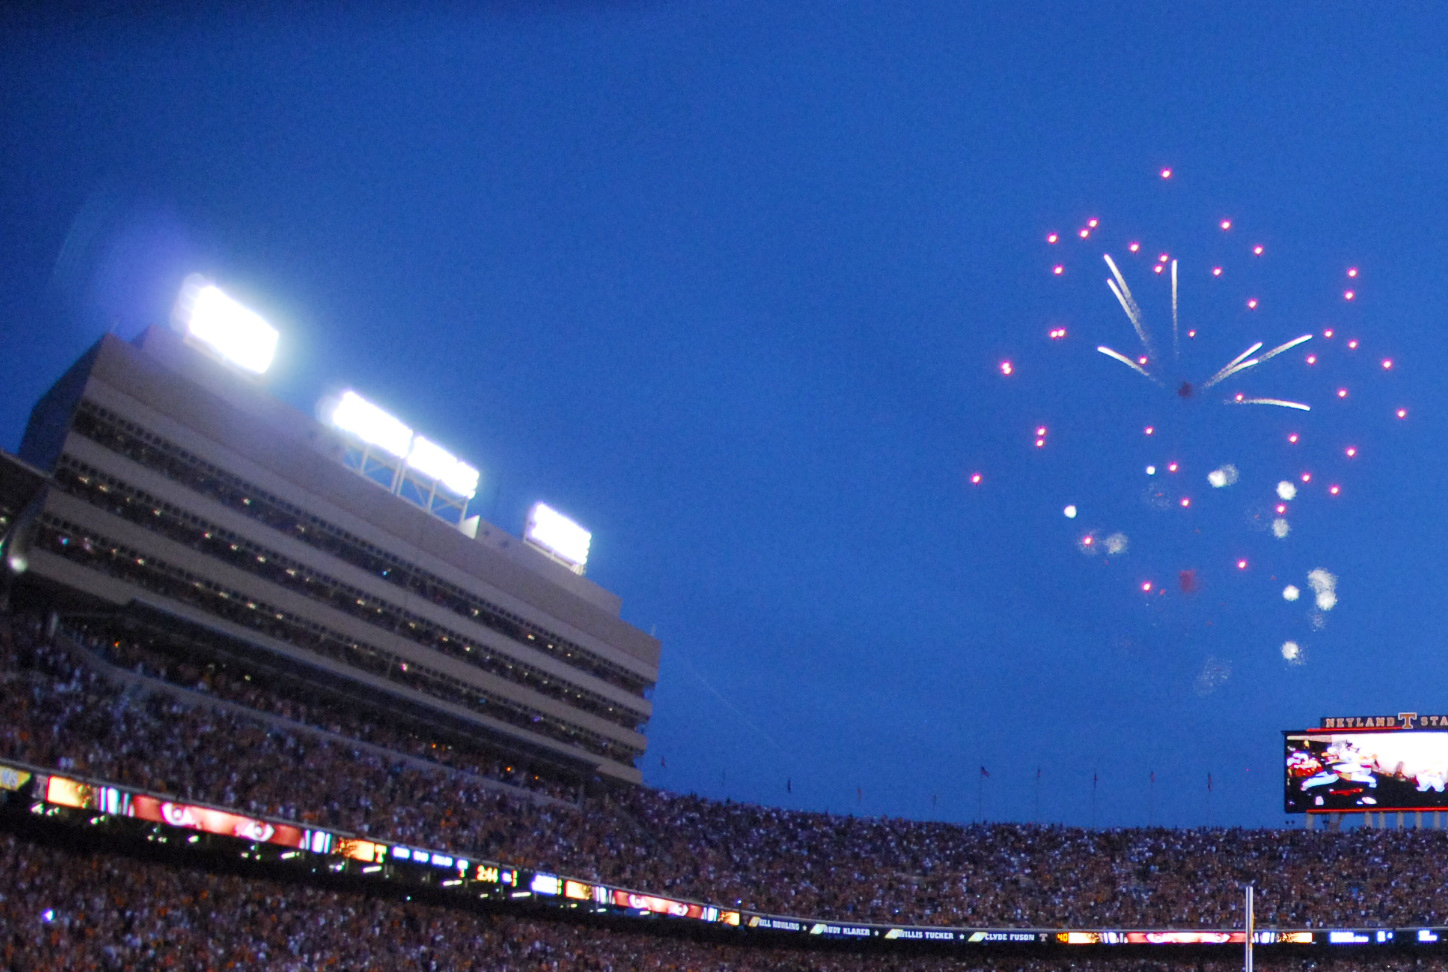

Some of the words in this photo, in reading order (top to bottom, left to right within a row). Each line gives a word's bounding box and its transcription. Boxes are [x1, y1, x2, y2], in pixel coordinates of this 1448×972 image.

[1325, 717, 1395, 728] NEYLAND
[1398, 712, 1417, 729] T
[476, 864, 498, 883] 2:44
